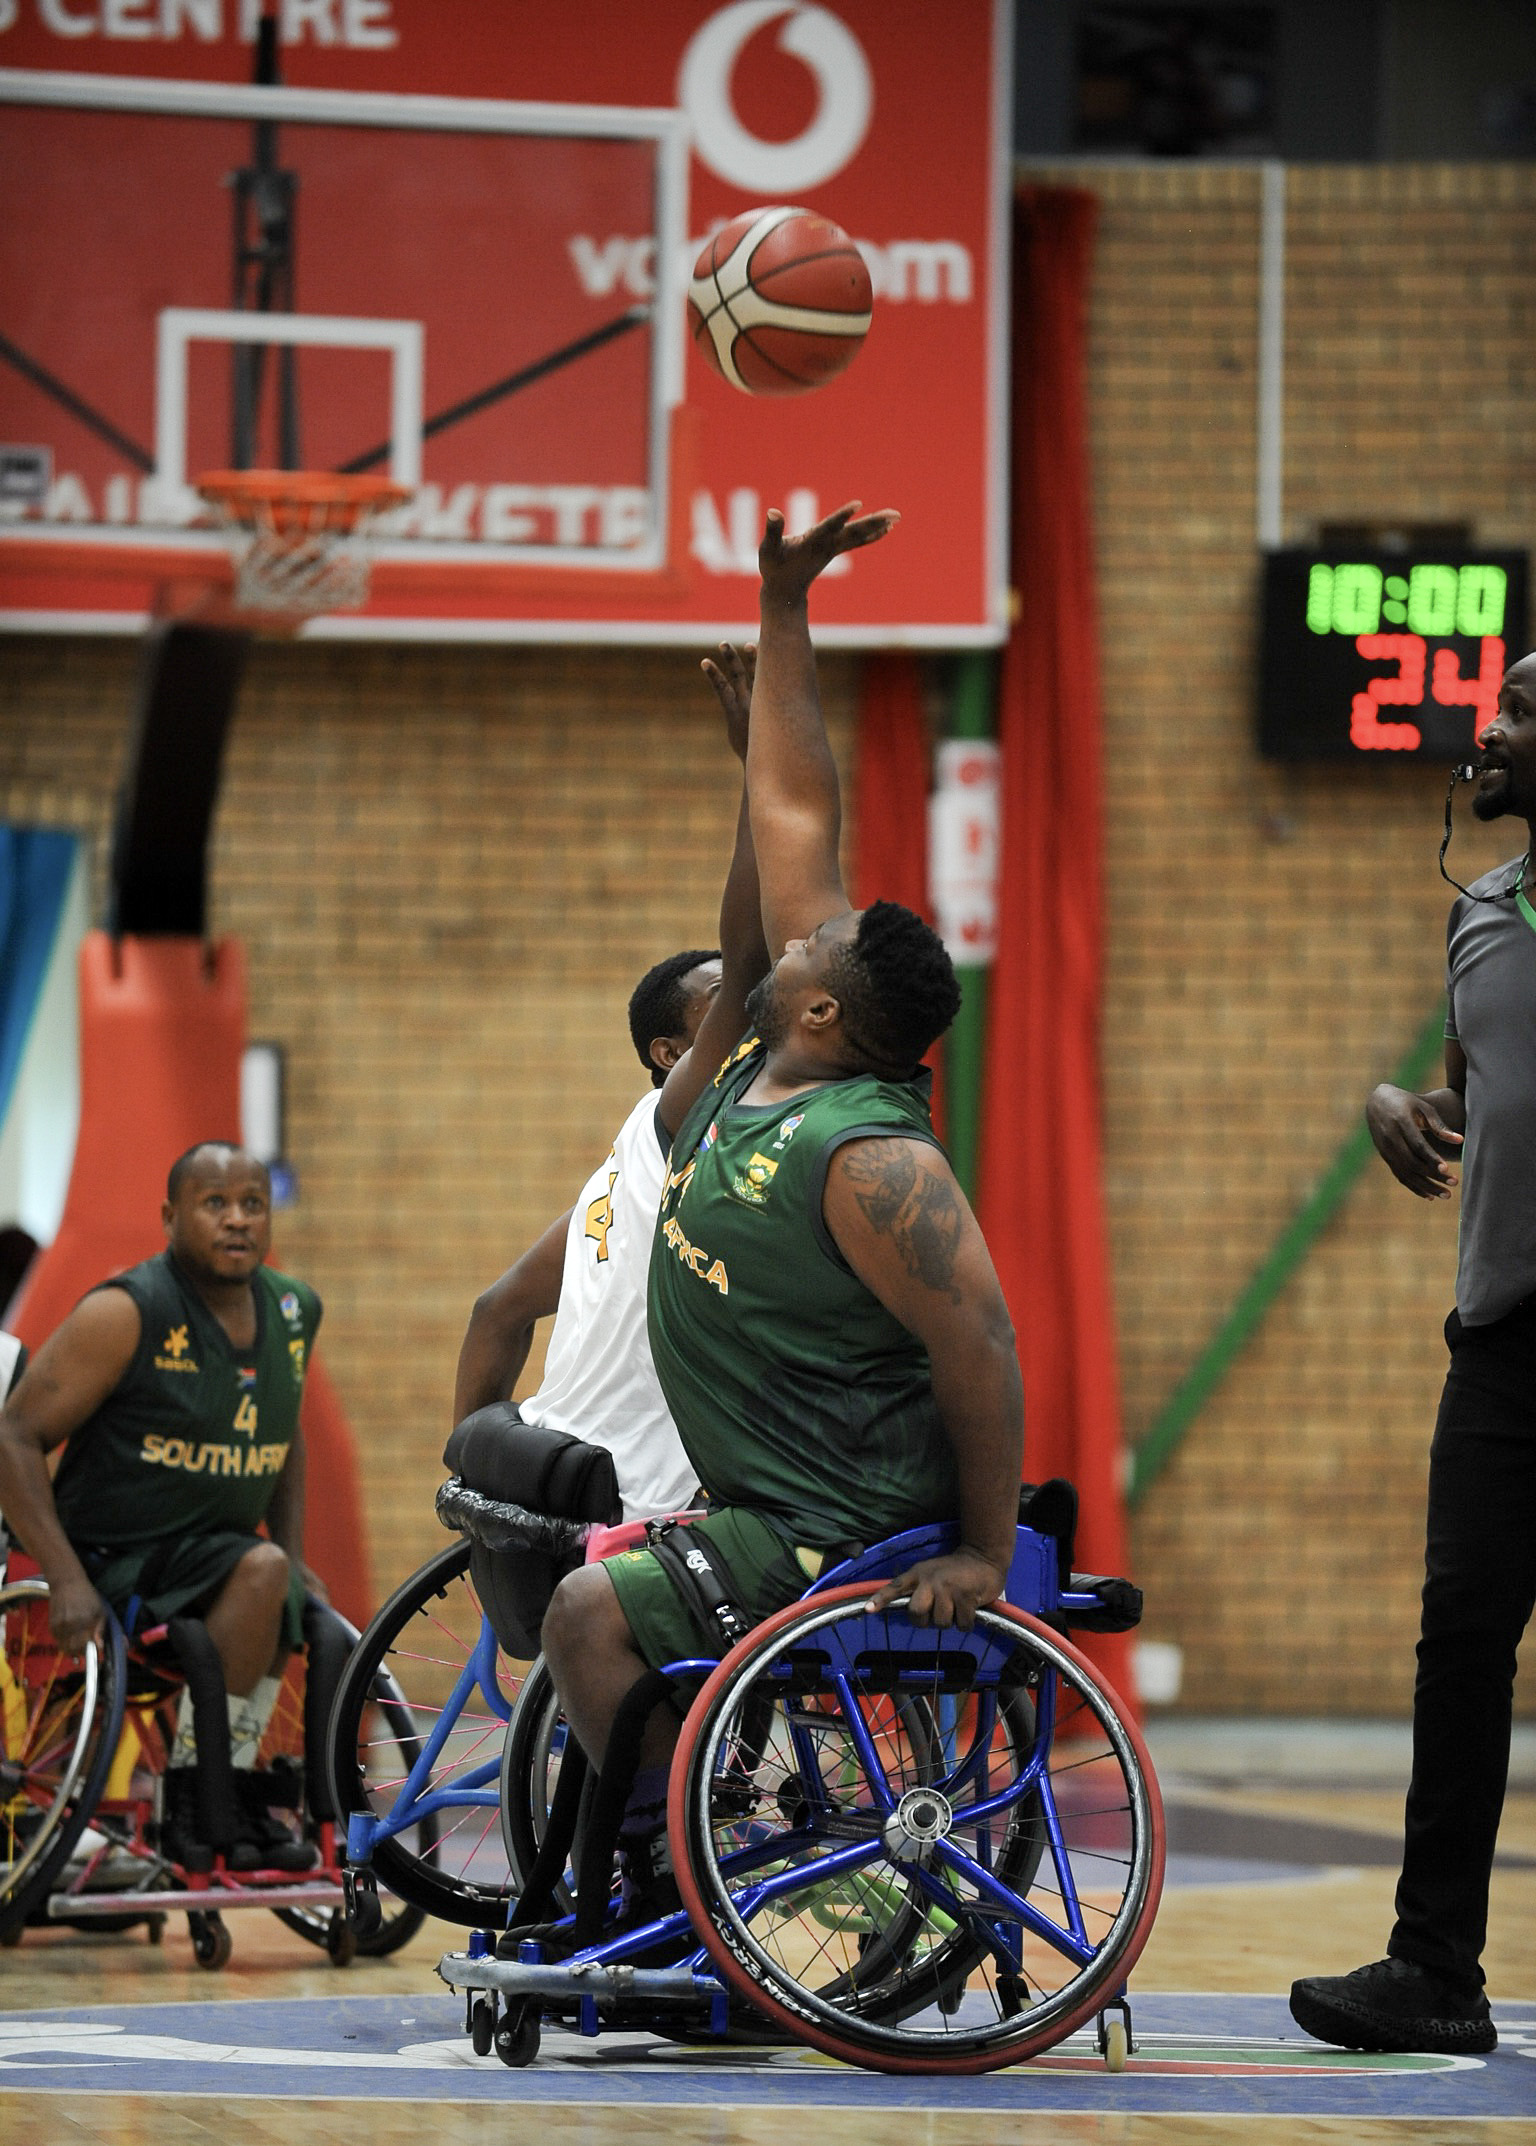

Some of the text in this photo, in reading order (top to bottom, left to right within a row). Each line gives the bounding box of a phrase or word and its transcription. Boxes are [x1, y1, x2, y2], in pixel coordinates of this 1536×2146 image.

[1306, 563, 1507, 636] 10:00
[1350, 633, 1506, 750] 24
[233, 1394, 258, 1440] 4
[140, 1433, 242, 1477] SOUTH
